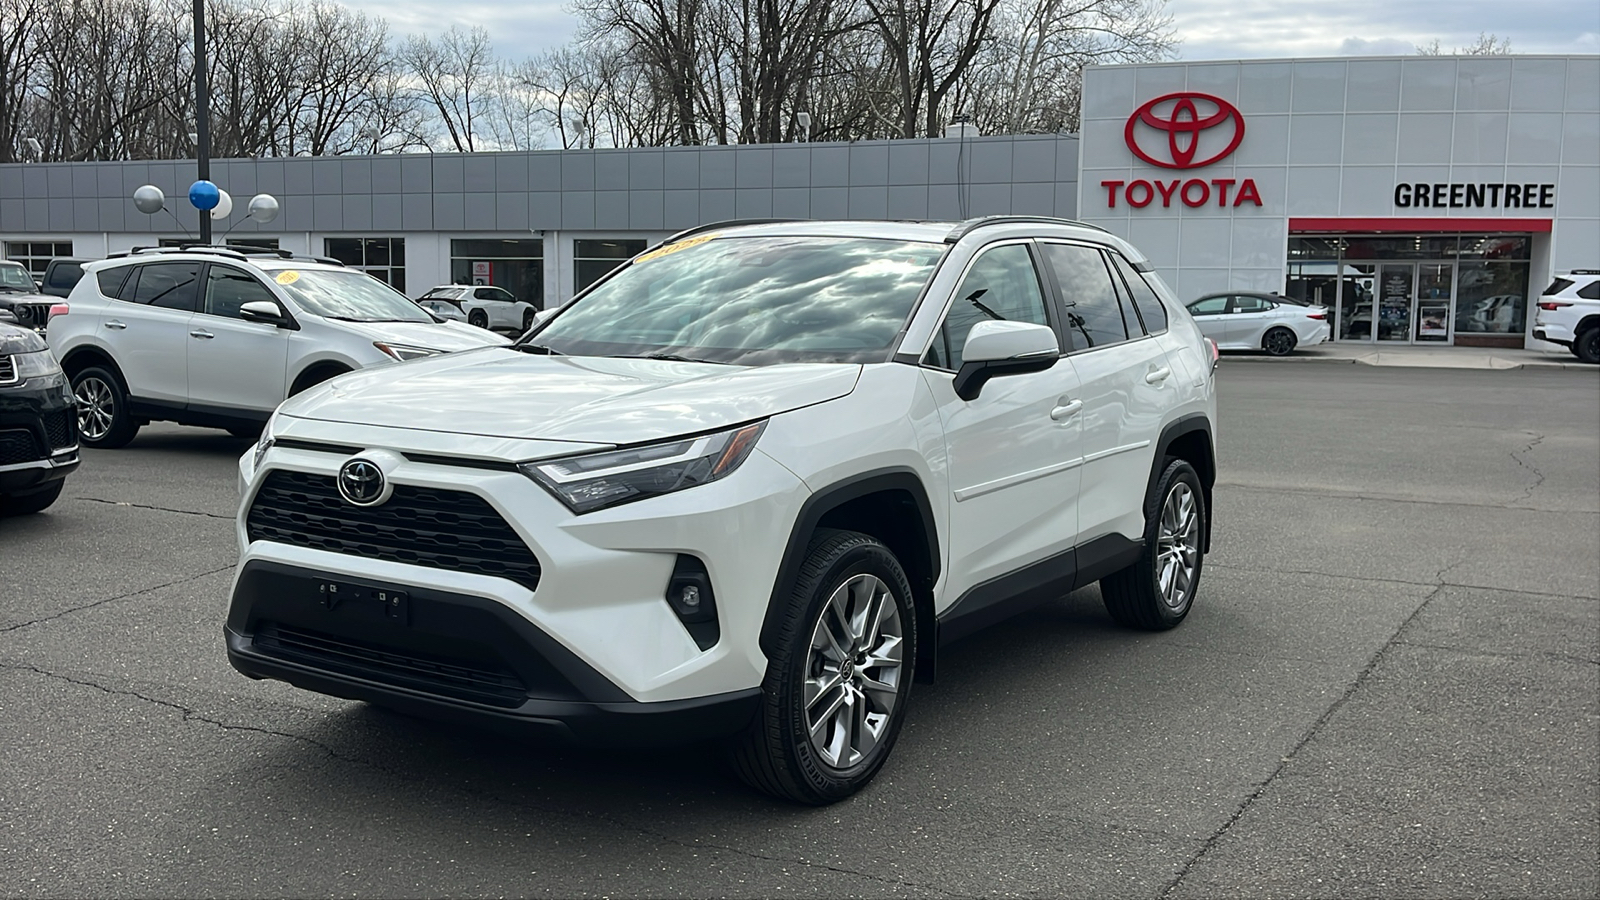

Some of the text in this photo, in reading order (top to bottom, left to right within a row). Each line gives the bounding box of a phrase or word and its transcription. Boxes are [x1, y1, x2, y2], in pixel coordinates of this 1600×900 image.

[1101, 179, 1262, 208] TOYOTA
[1394, 182, 1555, 208] GREENTREE
[883, 556, 913, 605] MICHELIN
